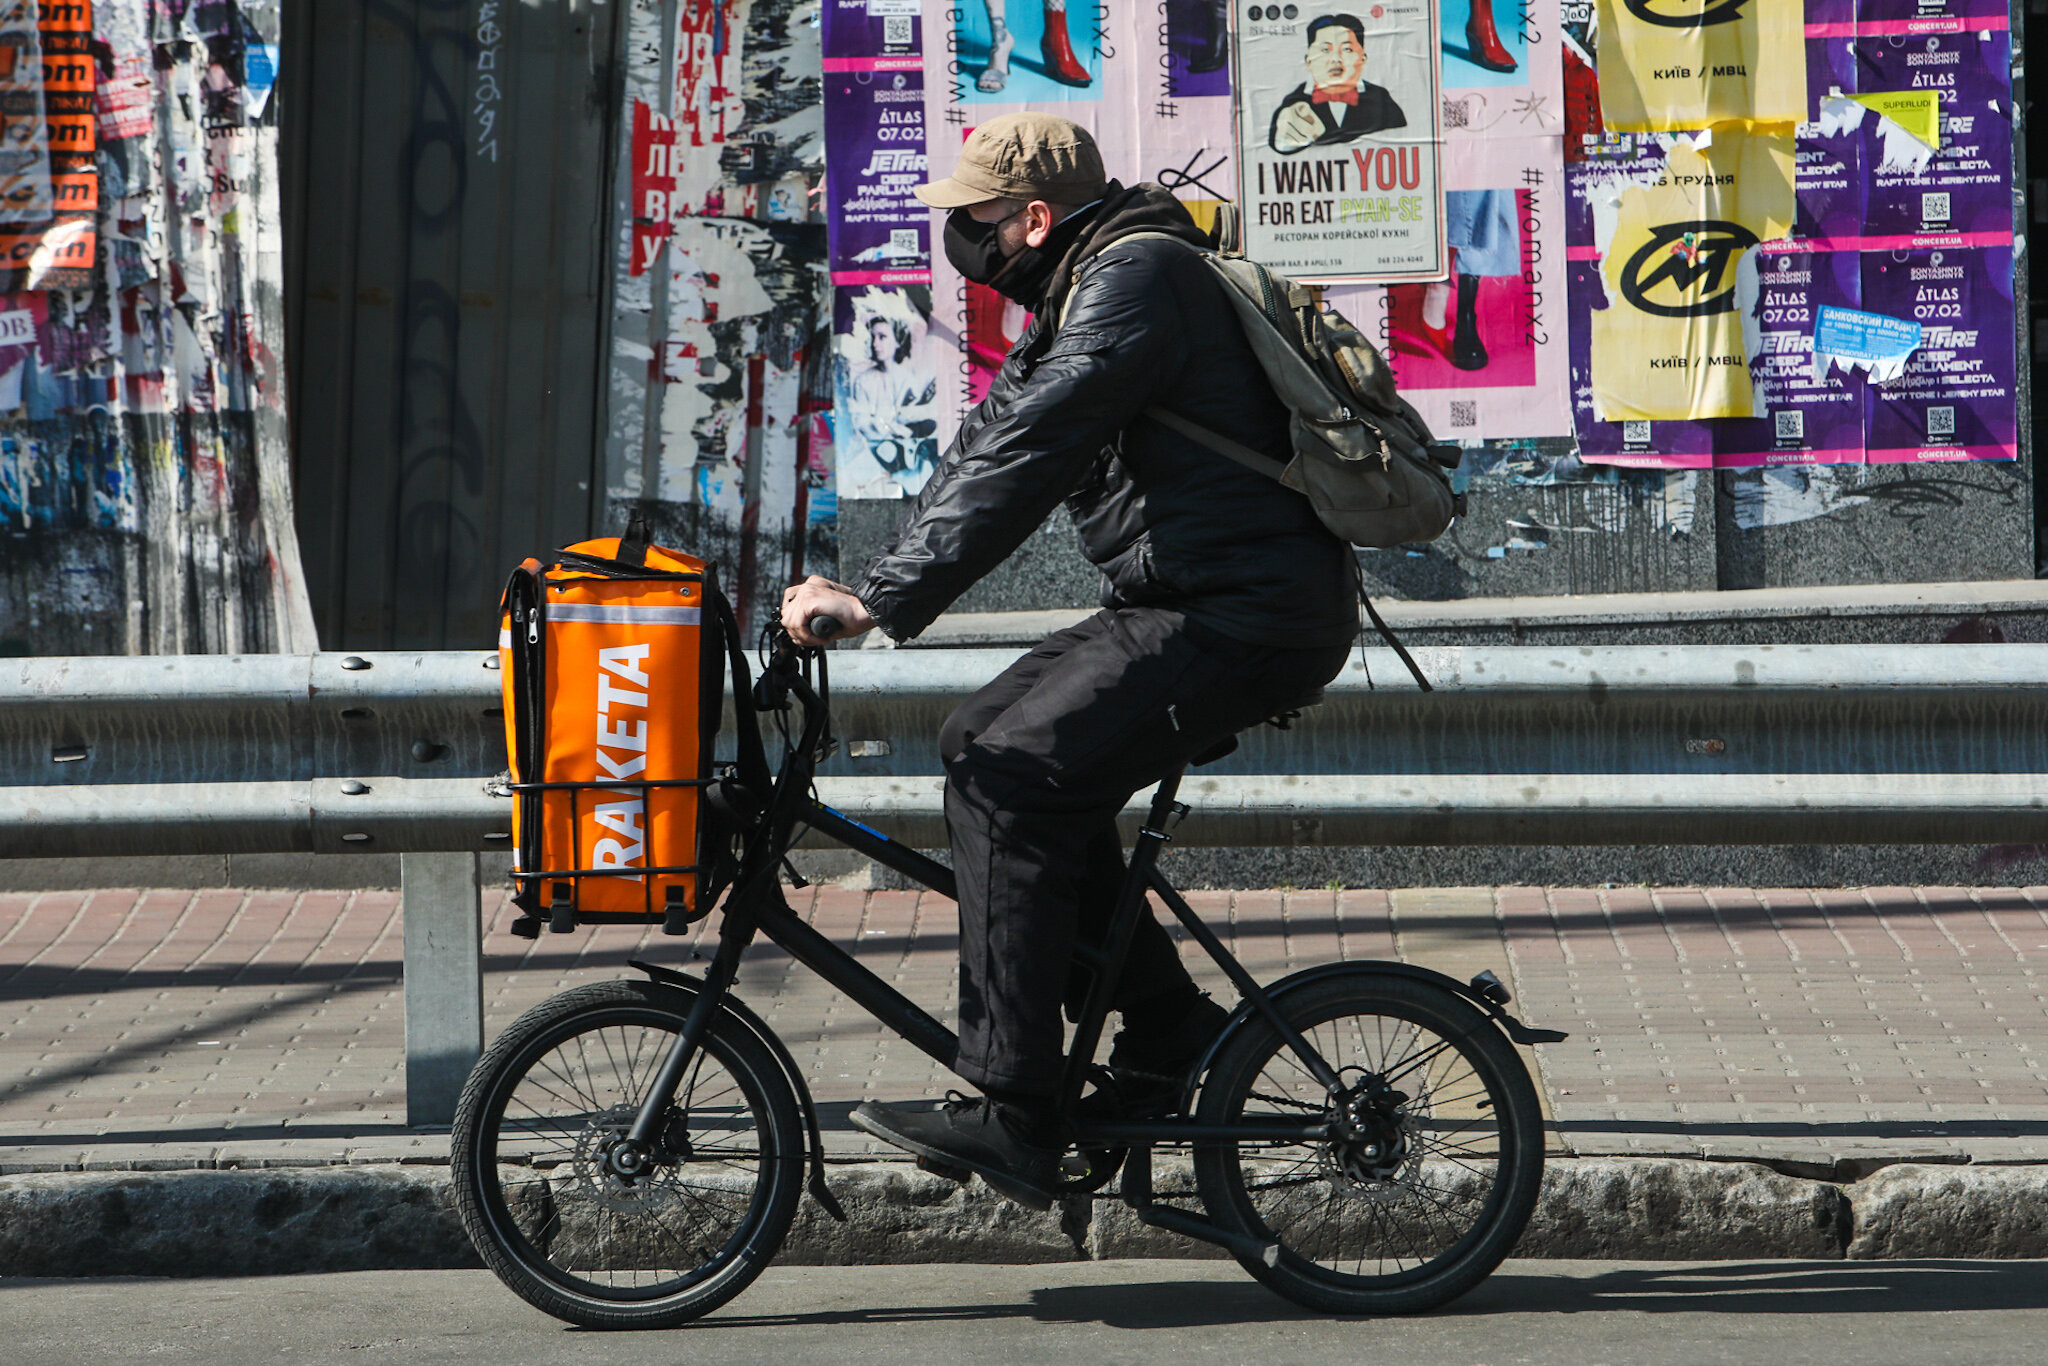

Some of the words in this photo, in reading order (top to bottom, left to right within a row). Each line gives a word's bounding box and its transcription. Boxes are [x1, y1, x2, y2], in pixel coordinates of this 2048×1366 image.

[1908, 21, 1958, 31] CONCERT.UA
[944, 0, 967, 126] #woma
[1653, 66, 1691, 80] КИЇВ
[1712, 65, 1747, 78] МВЦ
[1883, 100, 1931, 110] SUPERLUDI
[877, 127, 924, 141] 07.02
[861, 149, 928, 177] JETFIR
[1585, 158, 1666, 171] PARLIAMEN
[1936, 159, 1991, 171] SELECTA
[1258, 163, 1264, 195] I
[1273, 159, 1350, 194] WANT
[1352, 146, 1420, 191] YOU
[1674, 174, 1735, 187] ГРУДНЯ
[1975, 174, 2001, 184] STAR
[1259, 202, 1295, 226] FOR
[1301, 200, 1334, 224] EAT
[1341, 196, 1423, 223] PYAN-SE
[1274, 232, 1320, 242] РЕСТОРАН
[1322, 229, 1379, 240] КОРЕЙСЬКОЇ
[1381, 229, 1409, 239] КУХНІ
[1912, 236, 1962, 247] CONCERT.UA
[1521, 166, 1549, 346] #womanx2
[1762, 309, 1810, 322] 07.02
[1914, 303, 1962, 318] 07.02
[1822, 308, 1881, 327] БАНКОВСКИЙ
[1883, 317, 1918, 333] КРЕДИТ
[1920, 326, 1979, 348] ETFIRE
[1650, 355, 1688, 369] КИЇВ
[1708, 355, 1744, 368] МВЦ
[1765, 356, 1805, 367] DEEP
[1917, 351, 1957, 362] DEEP
[1902, 360, 1984, 373] ARLIAMENT
[1941, 373, 1996, 385] SELECTA
[1908, 390, 1935, 400] TONE
[1941, 389, 1978, 399] JEREMY
[1979, 387, 2005, 398] STAR
[1766, 454, 1816, 463] CONCERT.UA
[1917, 449, 1968, 459] CONCERT.UA
[593, 643, 651, 883] RAKETA
